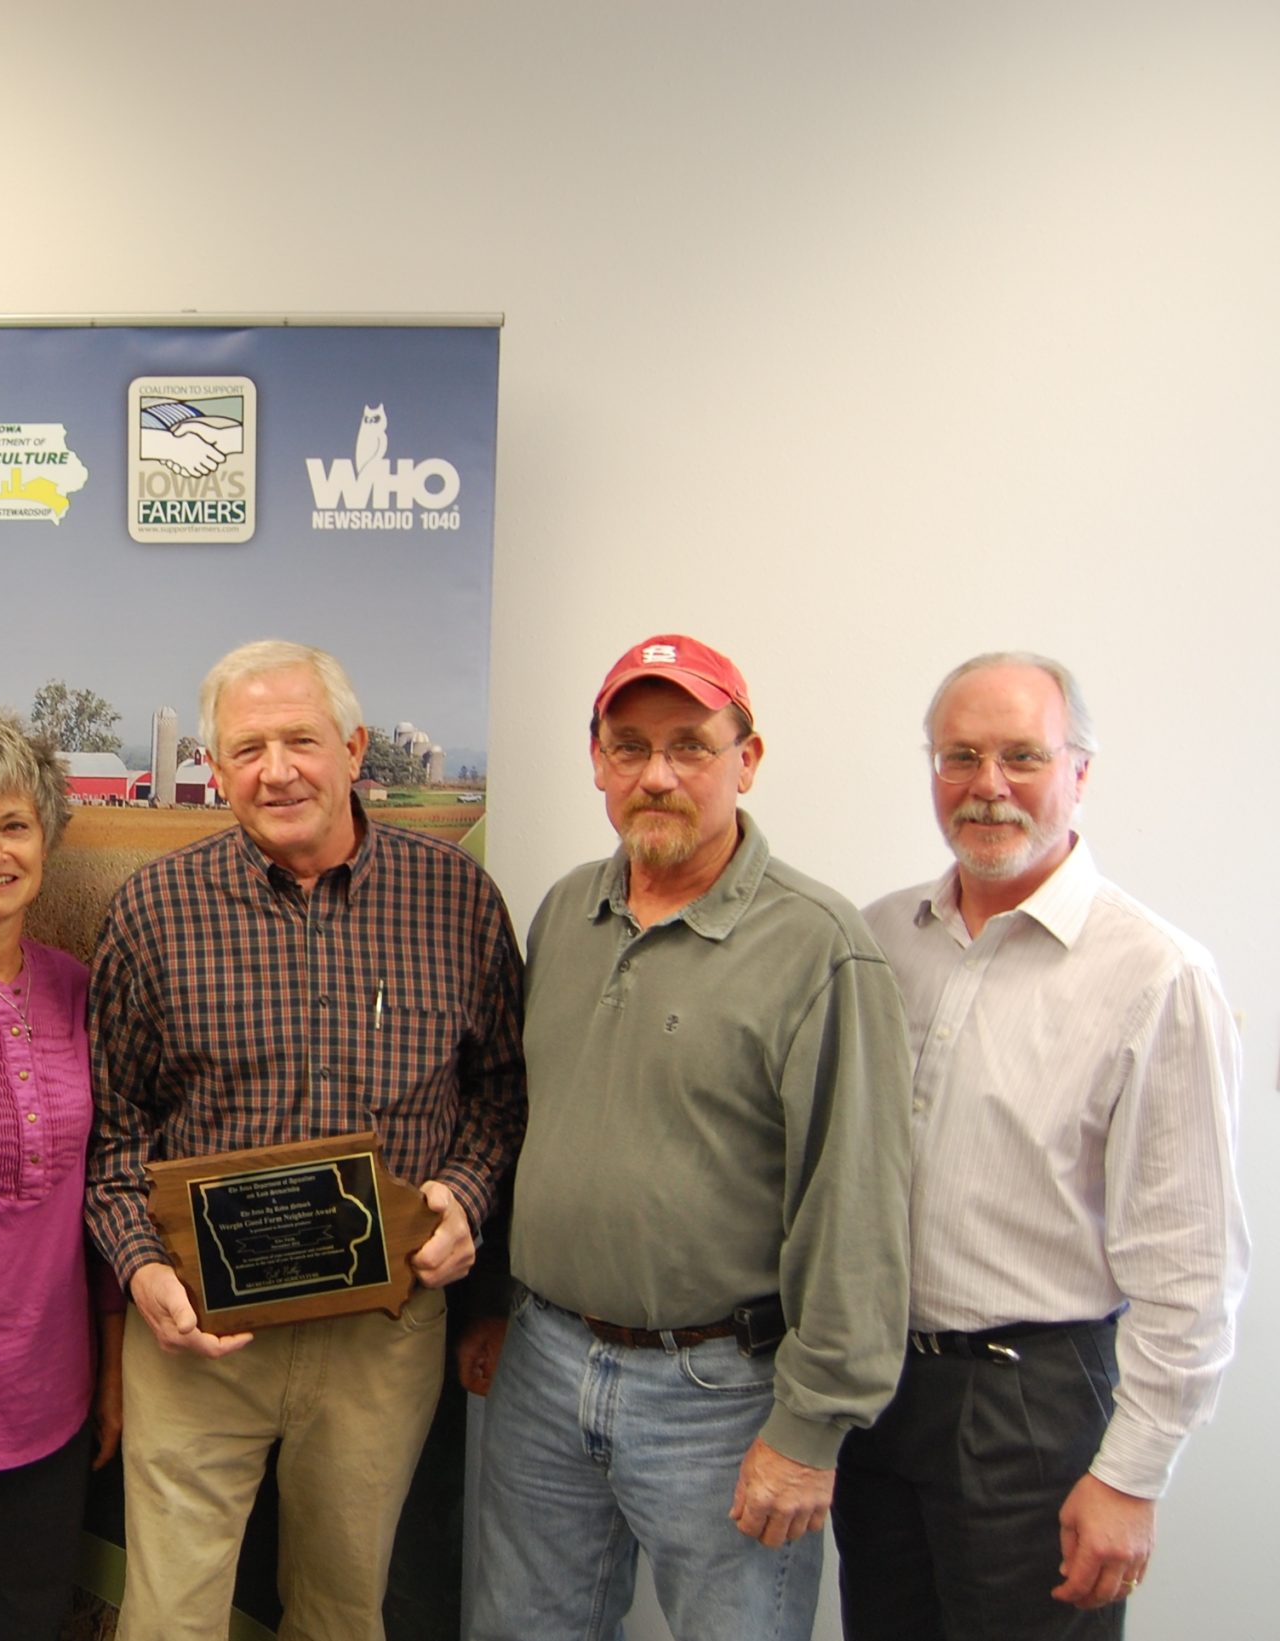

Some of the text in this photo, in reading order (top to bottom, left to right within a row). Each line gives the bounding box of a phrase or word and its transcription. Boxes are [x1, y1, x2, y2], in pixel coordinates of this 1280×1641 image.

[139, 385, 245, 395] COALITION TO SUPPORT
[33, 438, 46, 447] OF
[138, 470, 246, 499] IOWA'S
[305, 458, 461, 510] WHO
[139, 500, 245, 523] FARMERS
[312, 511, 460, 530] NEWSRADIO 1040
[138, 525, 239, 534] www.supportfarmers.com
